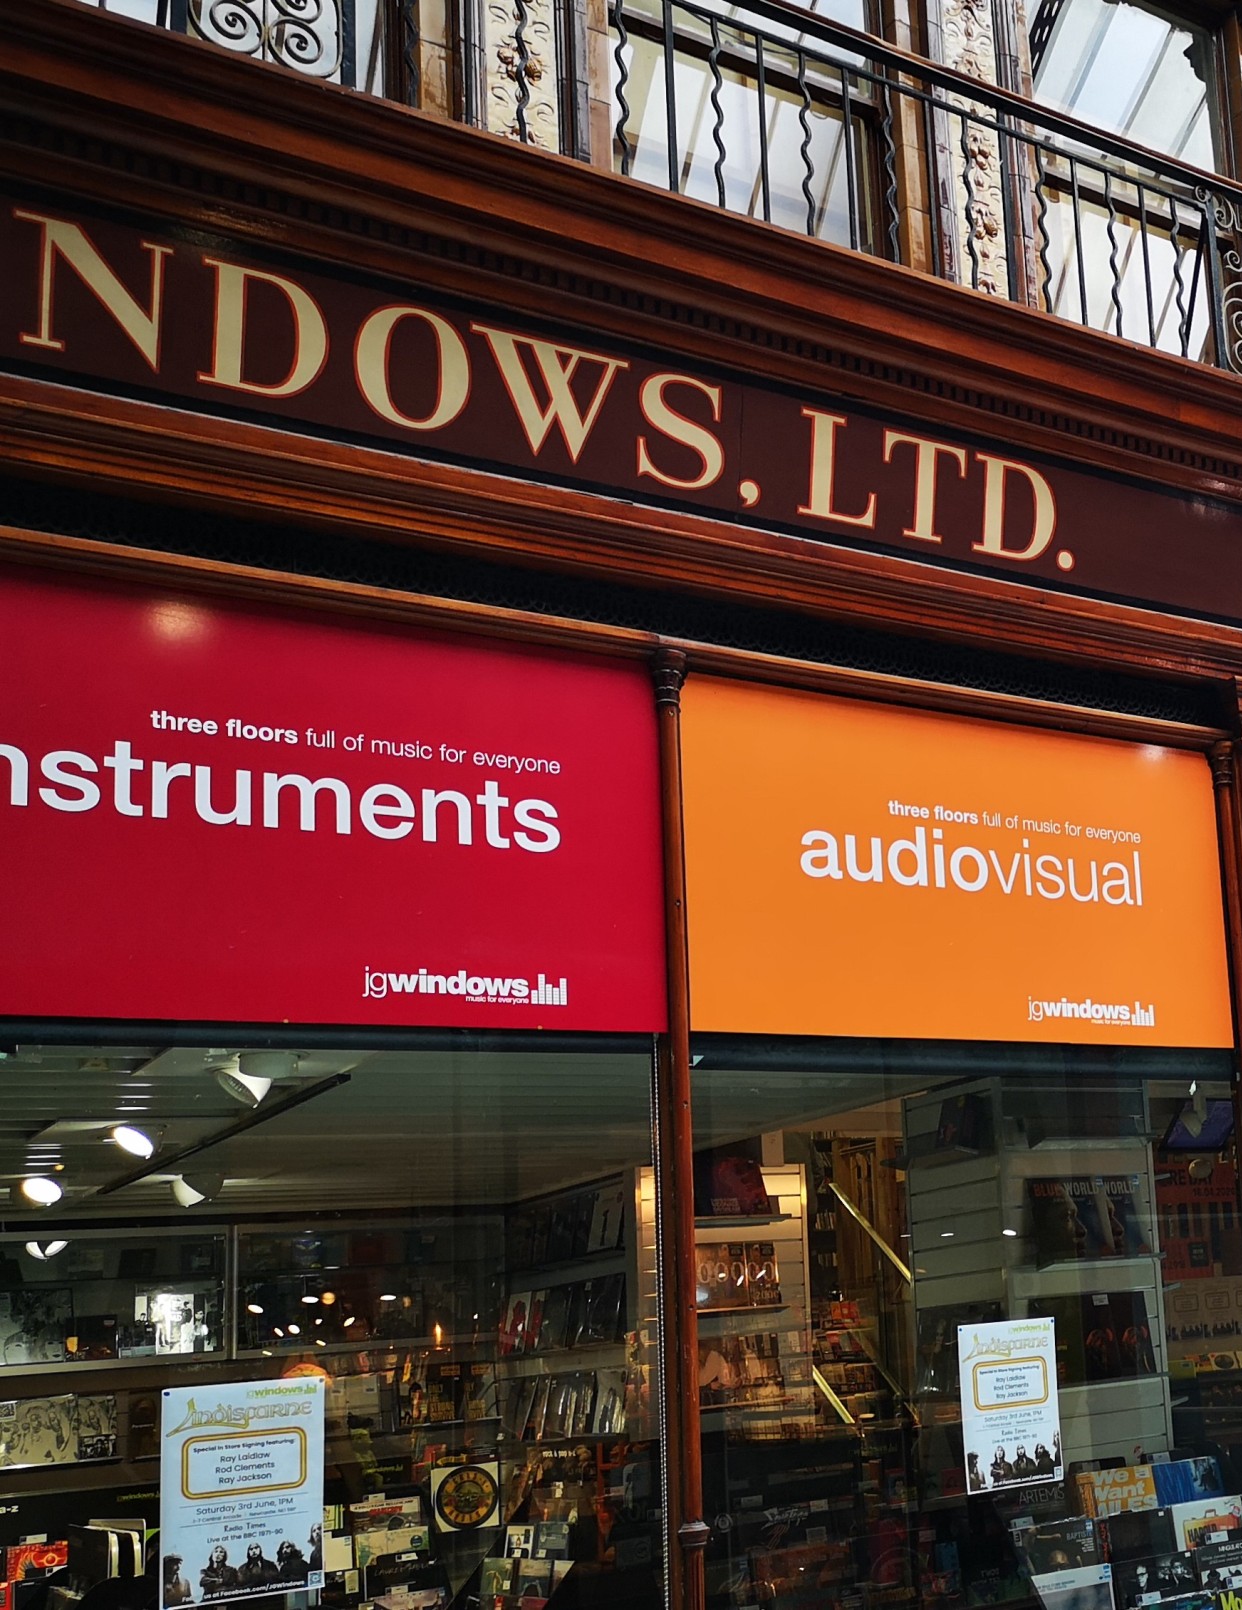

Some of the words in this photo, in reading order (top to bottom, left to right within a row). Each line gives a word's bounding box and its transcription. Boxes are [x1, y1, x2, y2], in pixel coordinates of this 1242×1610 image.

[797, 407, 1075, 572] LTD.
[150, 710, 218, 735] three
[225, 719, 299, 744] floors
[305, 728, 335, 749] full
[343, 733, 365, 751] of
[371, 739, 432, 760] music
[439, 744, 467, 763] for
[473, 751, 561, 774] everyone
[888, 800, 930, 818] three
[934, 805, 978, 824] floors
[982, 811, 1001, 828] full
[1005, 815, 1019, 830] of
[1022, 818, 1061, 835] music
[1065, 821, 1082, 837] for
[1085, 826, 1141, 845] everyone
[800, 826, 1143, 906] audiovisual
[362, 966, 529, 998] jgwindows
[1027, 996, 1131, 1021] jgwindows
[193, 1445, 216, 1454] Special
[242, 1441, 264, 1449] Signing
[220, 1455, 236, 1463] Ray
[238, 1452, 270, 1461] Laidlaw
[215, 1465, 232, 1474] Rod
[234, 1461, 275, 1472] Clements
[219, 1476, 235, 1485] Ray
[237, 1472, 272, 1482] Jackson
[1094, 1470, 1129, 1485] We
[1020, 1486, 1065, 1504] ARTEMIS
[196, 1504, 236, 1515] Saturday
[238, 1502, 252, 1511] 3rd
[255, 1499, 277, 1509] June,
[224, 1524, 243, 1532] Radio
[246, 1522, 266, 1530] Times
[243, 1531, 257, 1539] BBC
